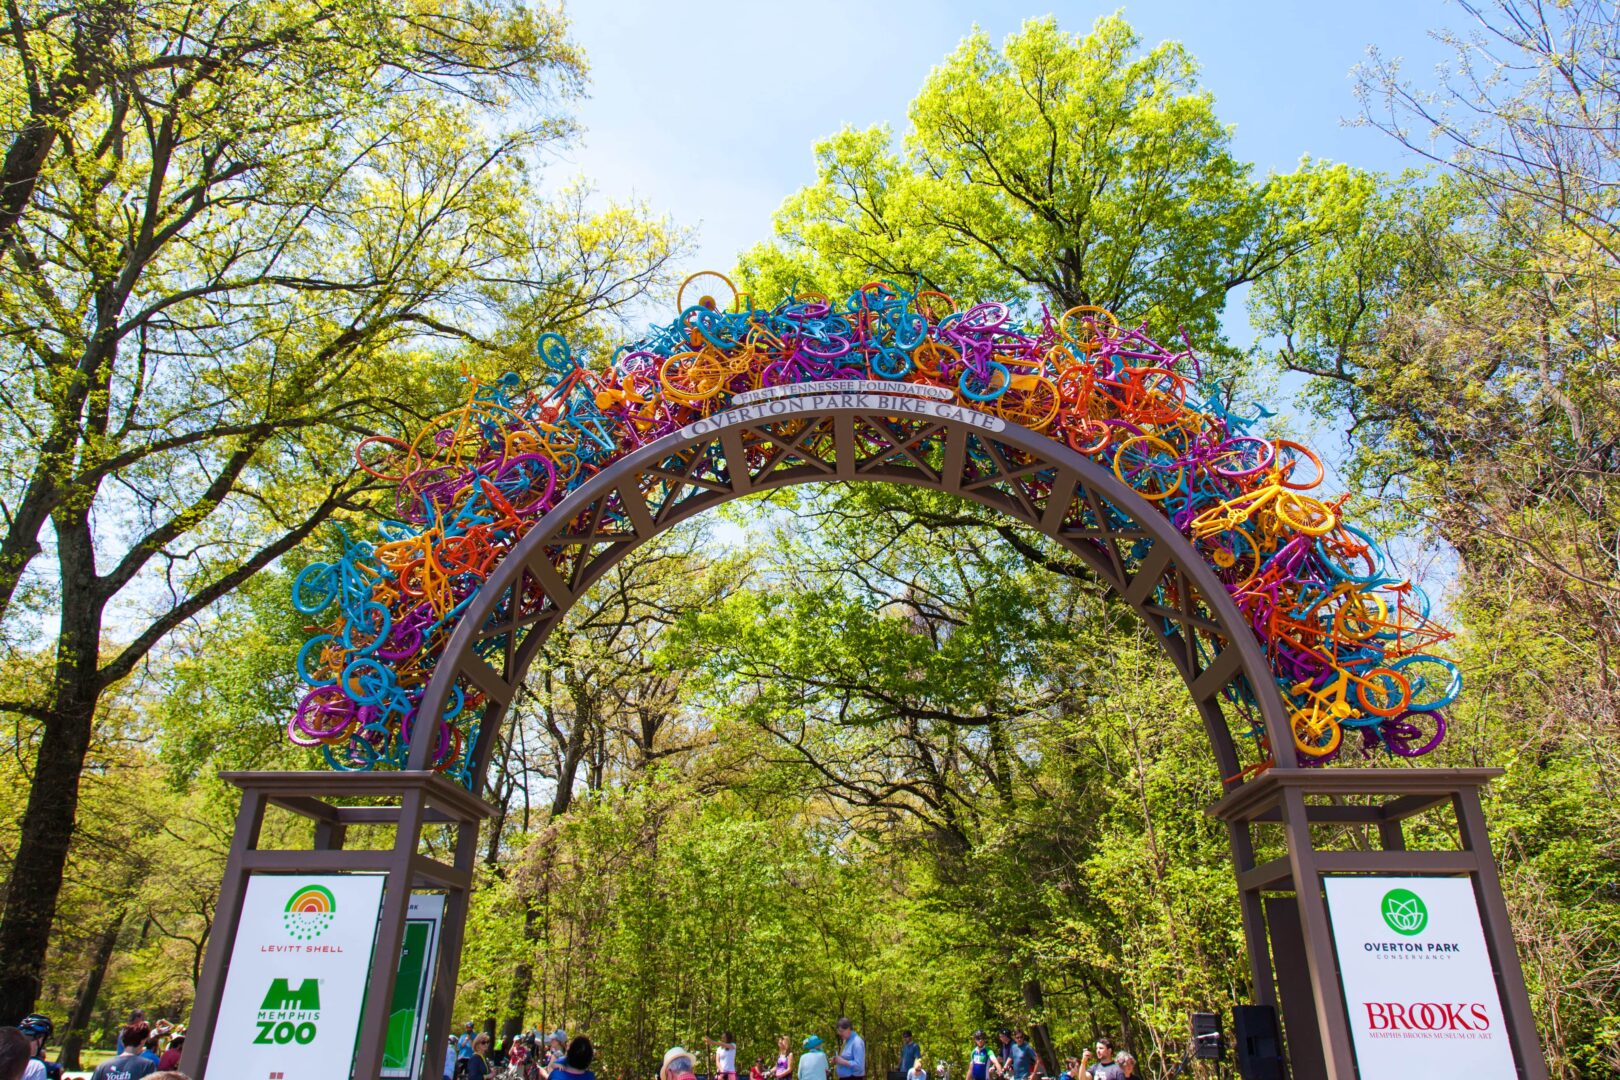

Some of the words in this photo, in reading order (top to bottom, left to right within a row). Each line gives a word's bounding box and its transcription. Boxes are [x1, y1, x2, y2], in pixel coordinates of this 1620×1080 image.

[740, 388, 776, 402] FIRST
[783, 381, 854, 395] TENNESSEE
[859, 380, 948, 398] FOUNDATION
[691, 399, 804, 435] OVERTON
[812, 395, 869, 410] PARK
[878, 396, 927, 413] BIKE
[935, 403, 996, 430] GATE
[306, 945, 343, 953] SHELL
[1364, 942, 1424, 952] OVERTON
[1427, 943, 1460, 952] PARK
[257, 1011, 320, 1020] MEMPHIS
[1362, 1002, 1490, 1031] BROOKS
[252, 1021, 317, 1045] ZOO
[106, 1071, 131, 1080] Youth
